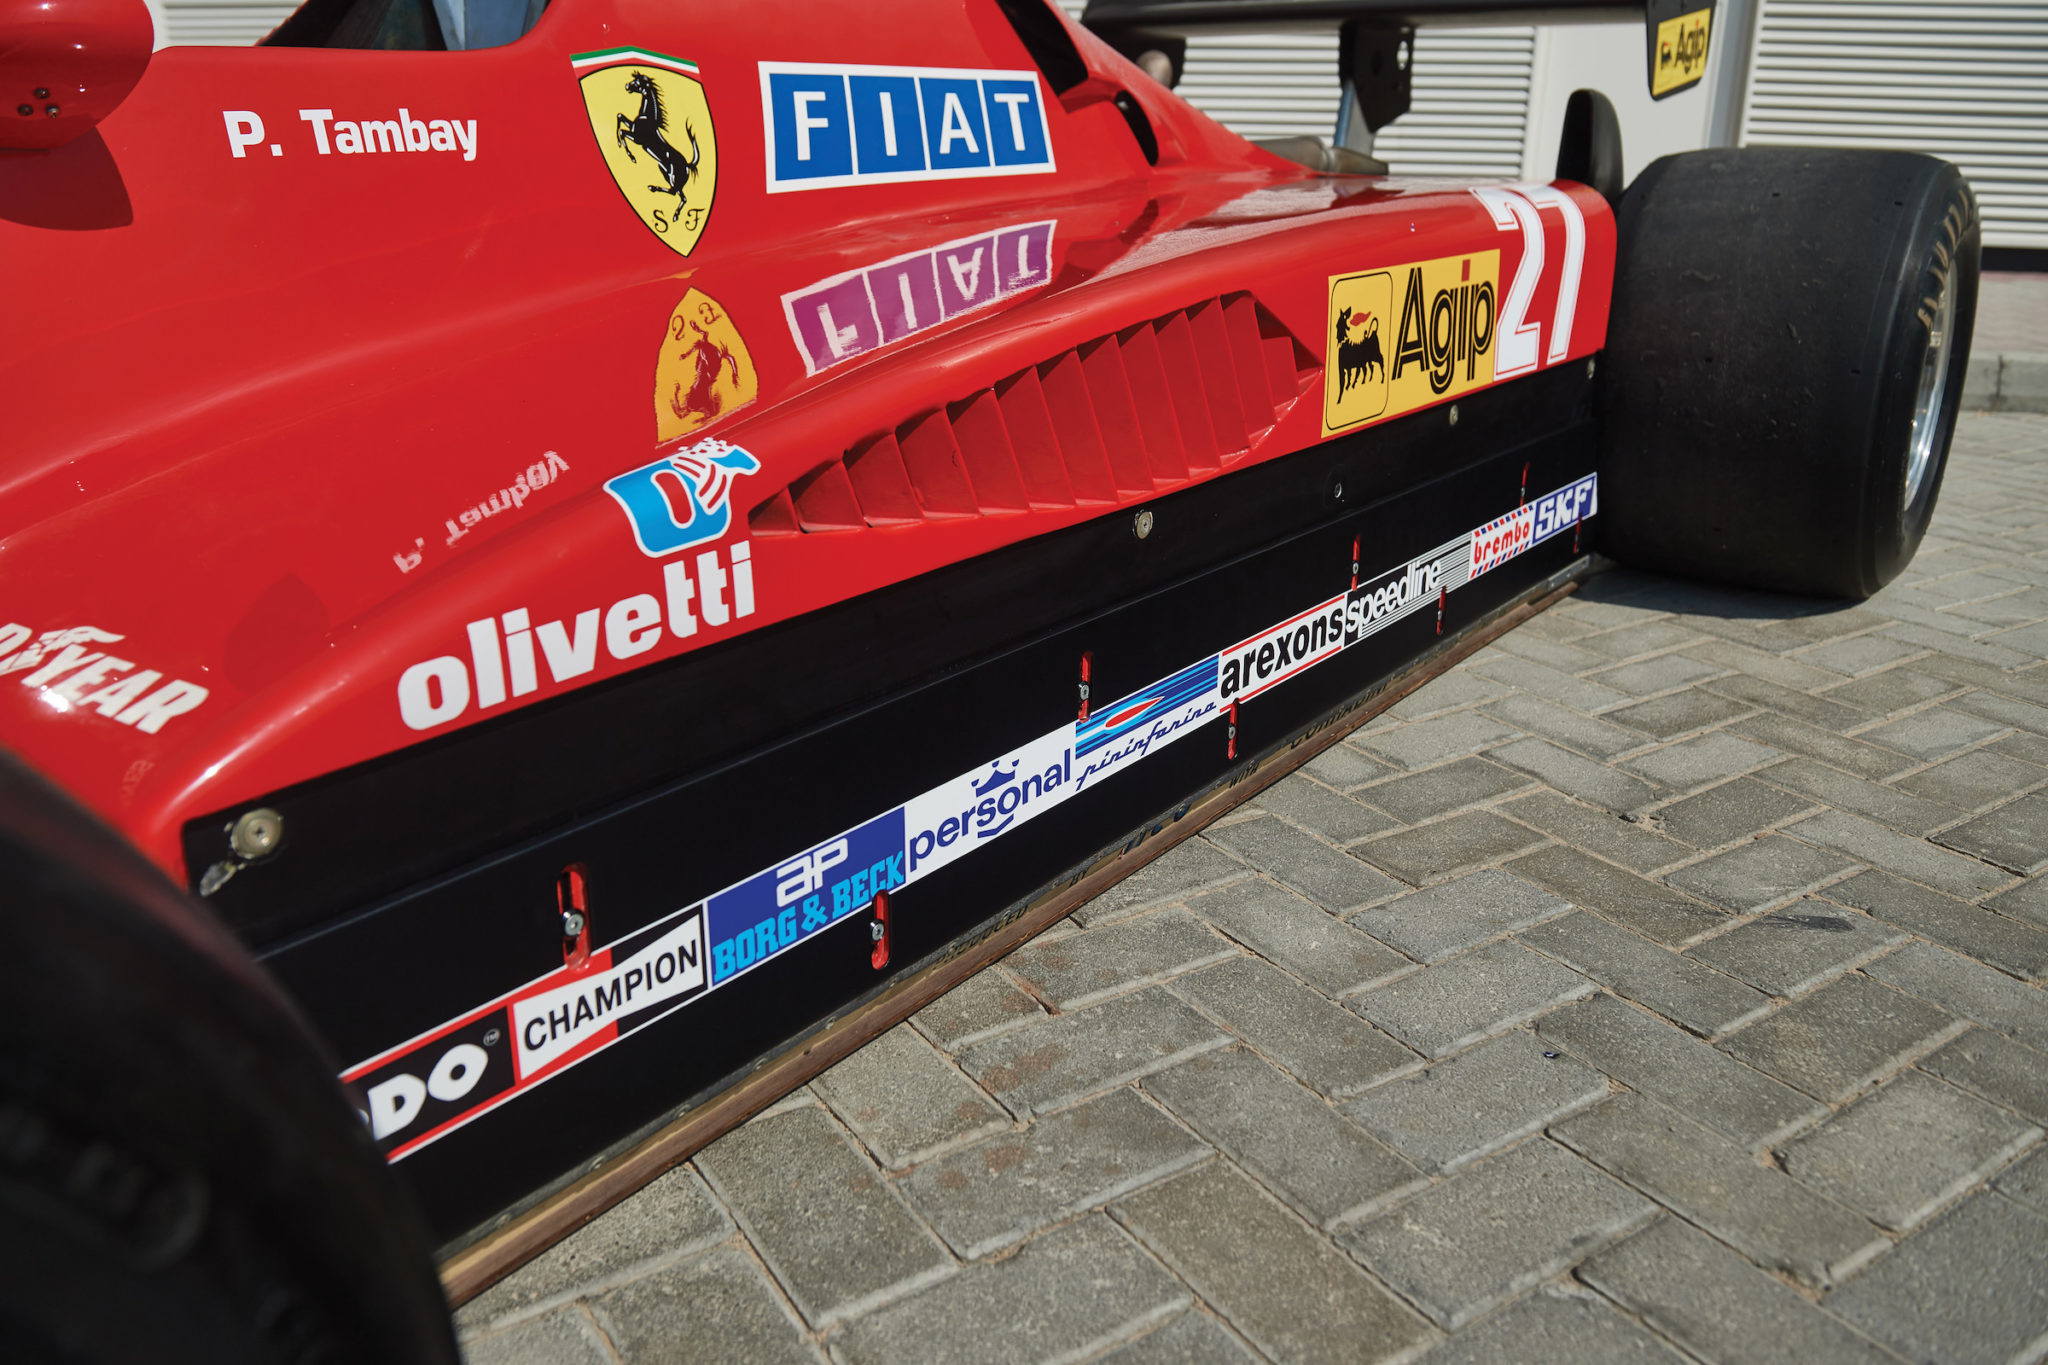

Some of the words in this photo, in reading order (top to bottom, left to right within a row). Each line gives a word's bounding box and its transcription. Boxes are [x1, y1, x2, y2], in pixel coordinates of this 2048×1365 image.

[1674, 18, 1705, 75] Agip
[223, 110, 283, 158] P.
[299, 108, 477, 161] Tambay
[793, 91, 1030, 161] FIAT
[1391, 258, 1495, 395] Agip
[1468, 183, 1586, 382] 27
[1474, 521, 1530, 565] brembo
[1535, 479, 1593, 540] SKF
[397, 540, 755, 731] olivetti
[1345, 559, 1442, 638] speedline
[1220, 607, 1343, 699] arexons
[1075, 702, 1217, 791] pininfarina
[909, 748, 1071, 872] personal
[712, 906, 798, 982] BORG
[801, 894, 828, 932] &
[831, 850, 905, 919] BECK
[524, 939, 698, 1051] CHAMPION
[357, 1043, 489, 1142] DO
